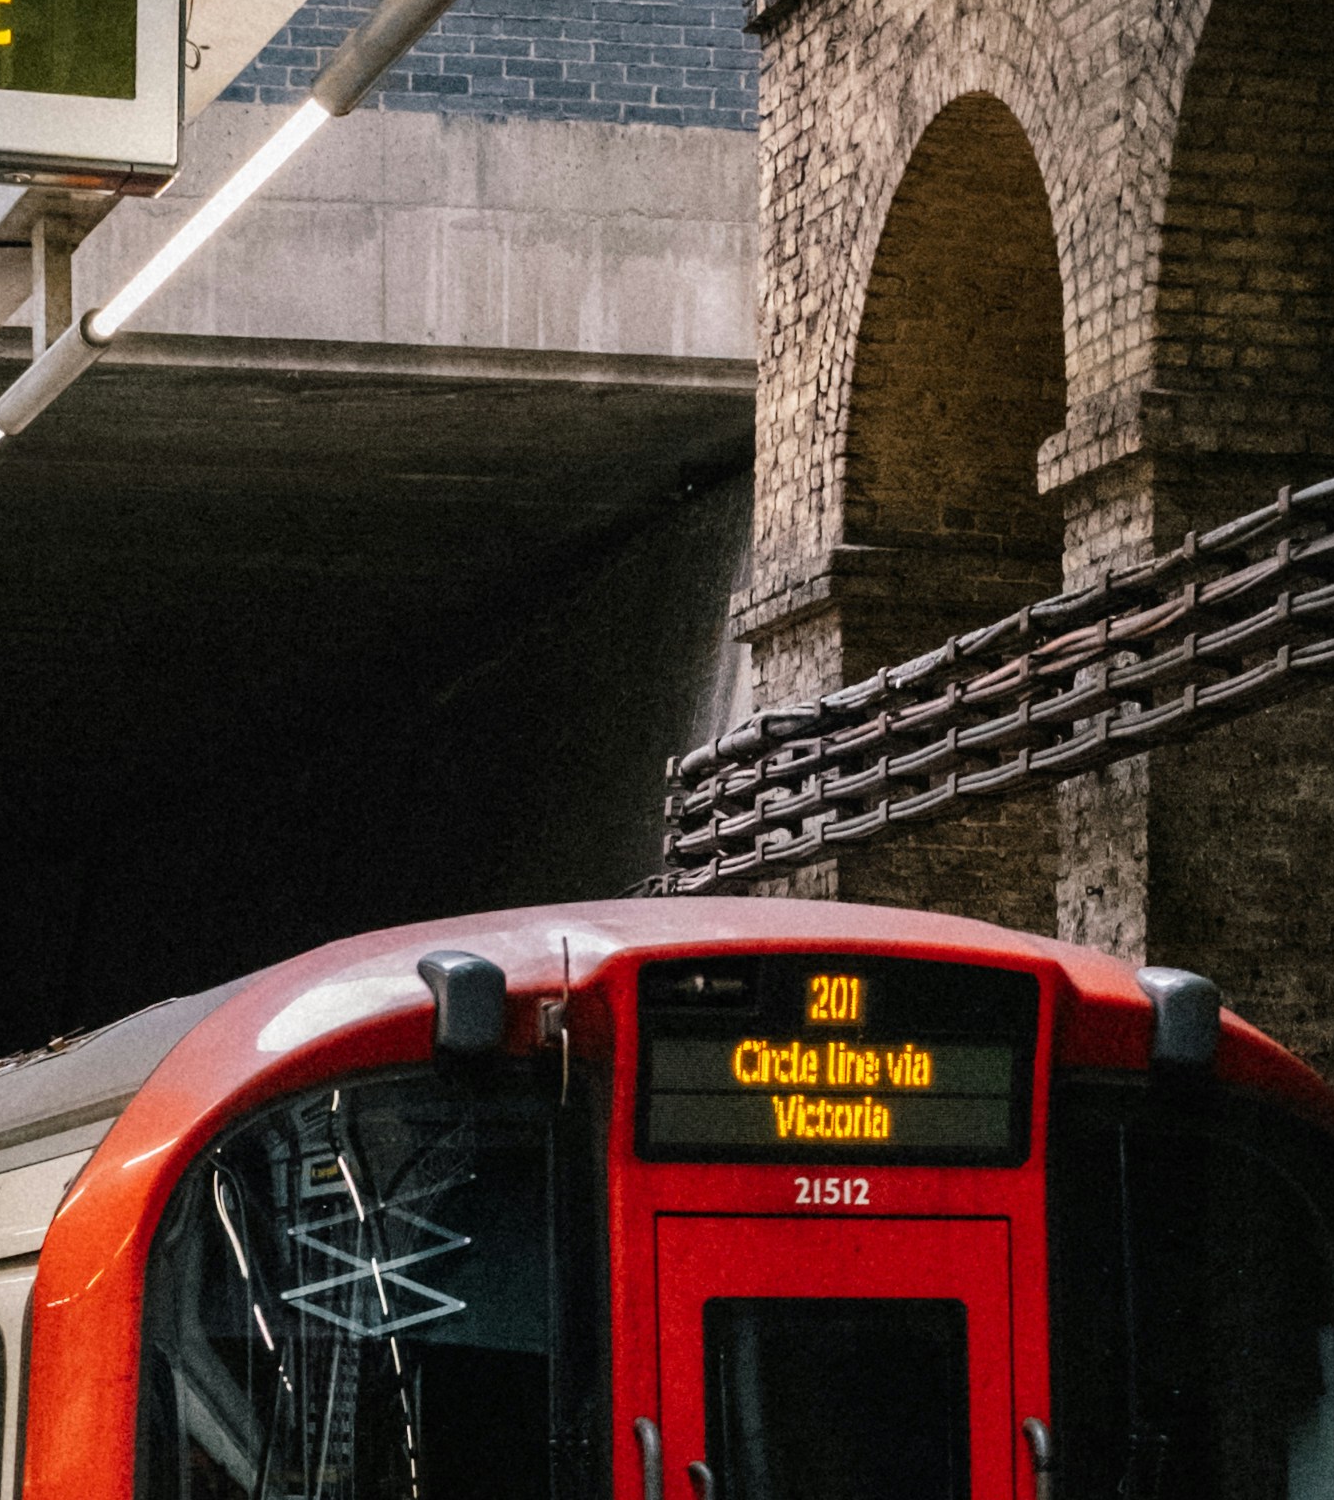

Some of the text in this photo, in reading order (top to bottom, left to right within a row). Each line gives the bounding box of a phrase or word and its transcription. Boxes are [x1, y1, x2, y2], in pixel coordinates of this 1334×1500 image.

[809, 976, 860, 1020] 201
[734, 1040, 932, 1087] Circle line via
[773, 1095, 891, 1139] Victoria
[795, 1178, 870, 1205] 21512
